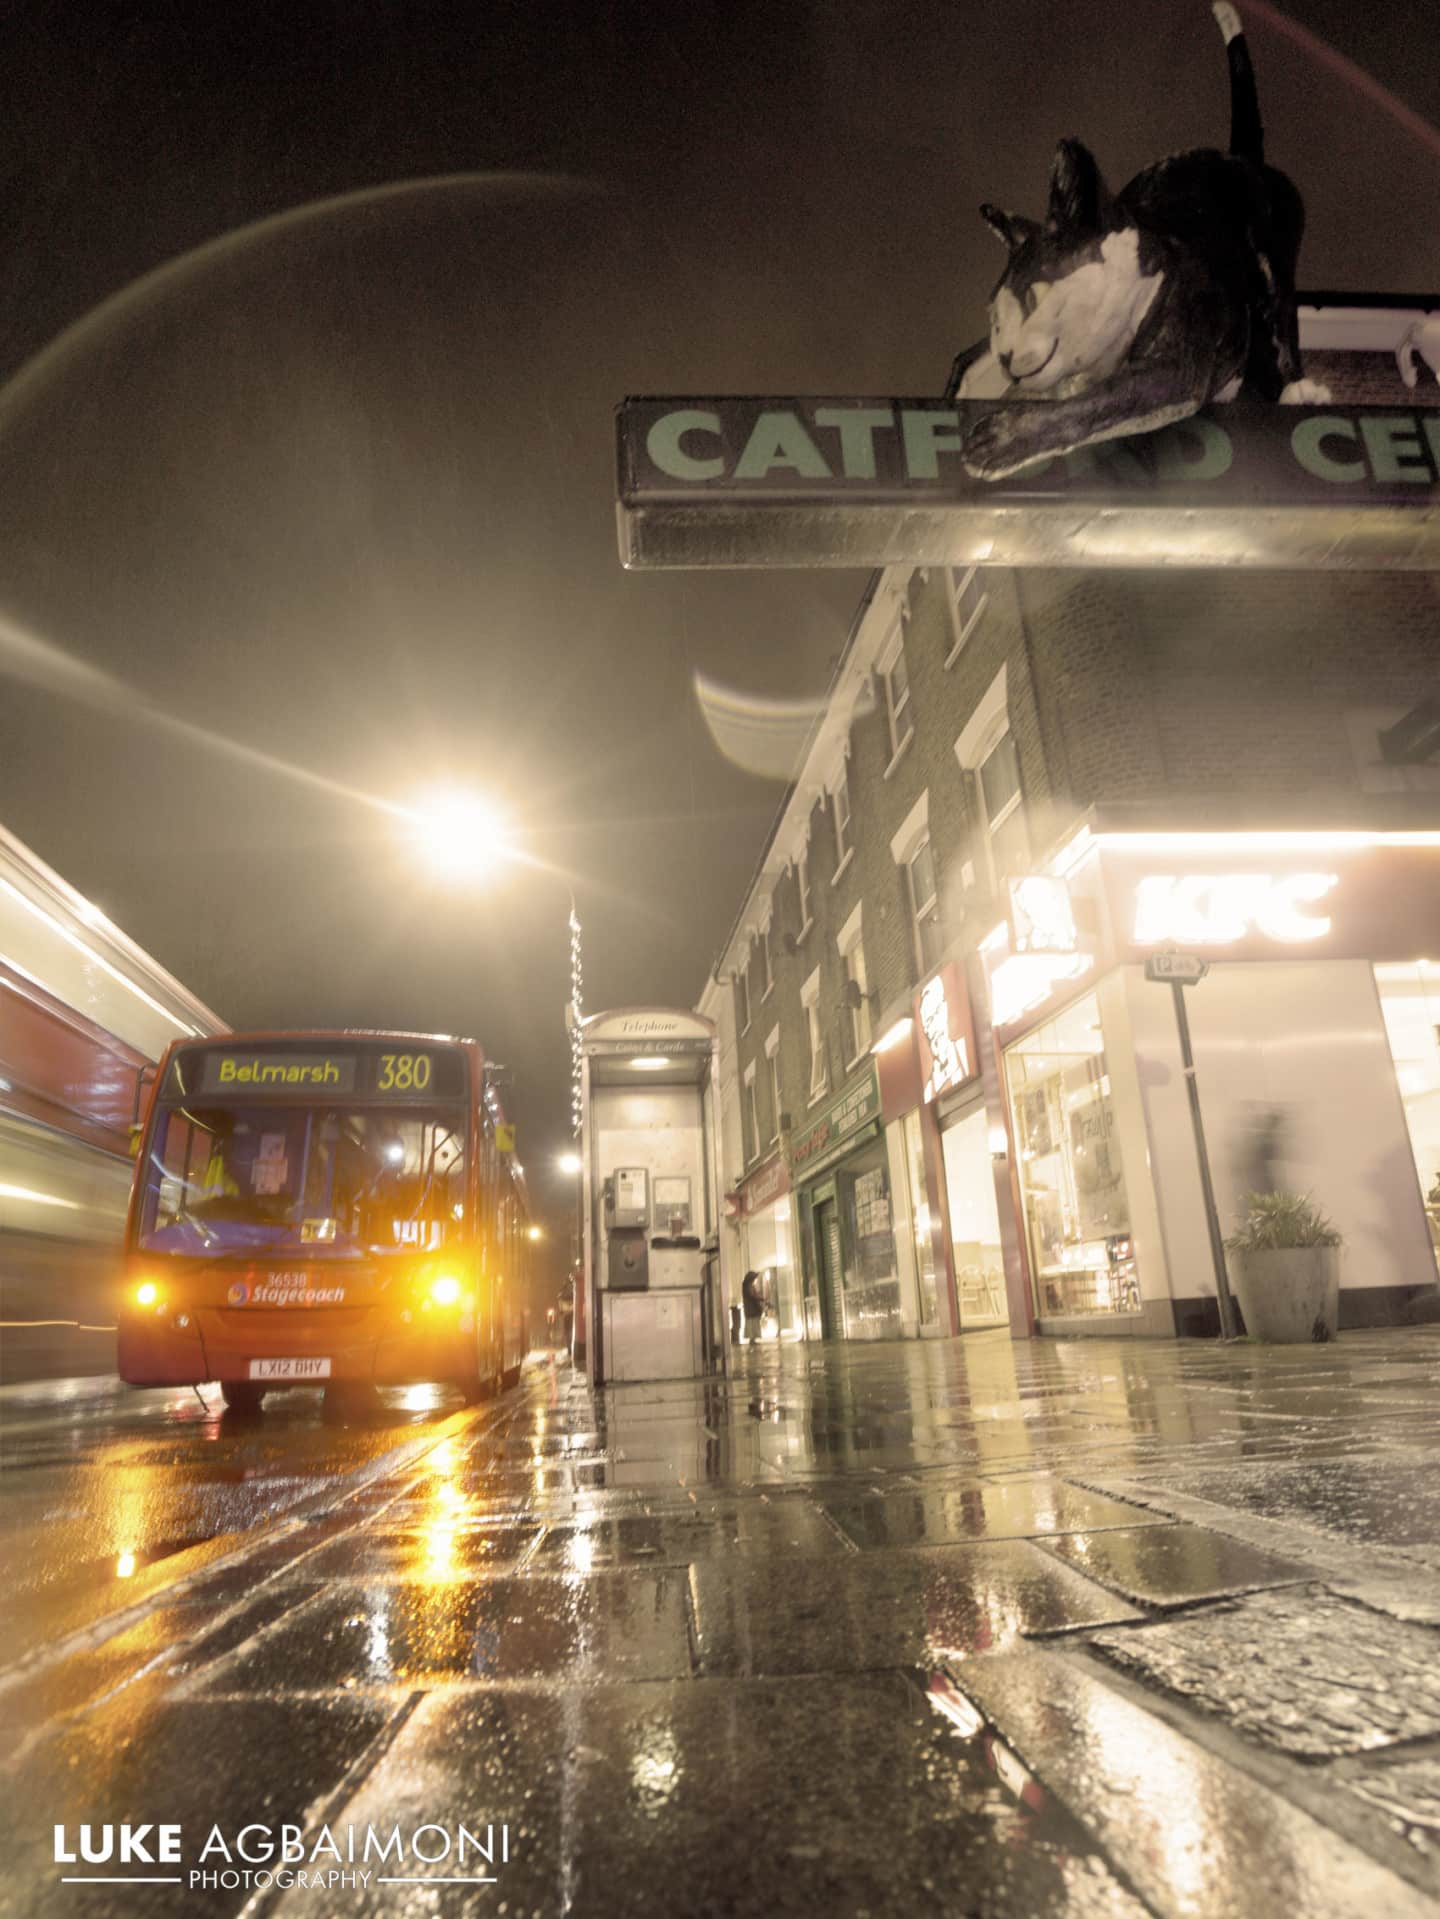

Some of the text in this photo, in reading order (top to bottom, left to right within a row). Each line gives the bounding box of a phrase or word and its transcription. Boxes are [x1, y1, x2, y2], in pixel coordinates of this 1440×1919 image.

[647, 409, 1440, 483] CATFD CE
[621, 1020, 679, 1033] Telephone
[219, 1055, 431, 1091] Belmarsh 380
[253, 1284, 345, 1306] Stagecoach
